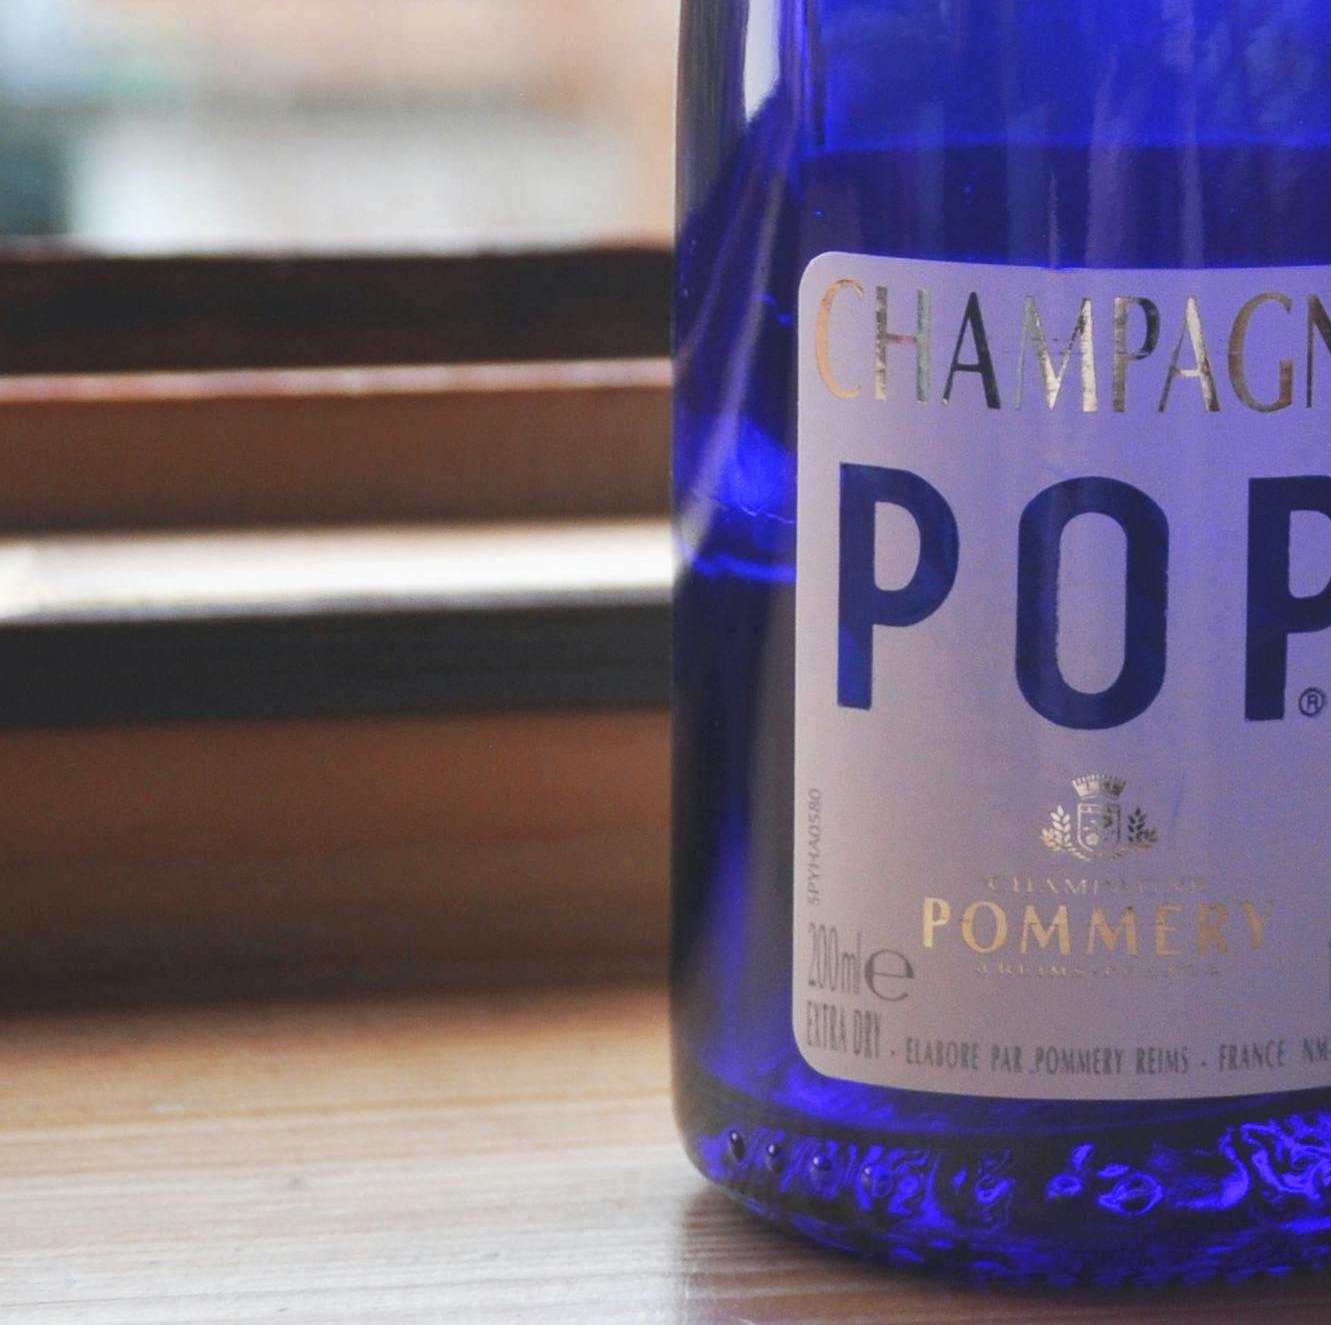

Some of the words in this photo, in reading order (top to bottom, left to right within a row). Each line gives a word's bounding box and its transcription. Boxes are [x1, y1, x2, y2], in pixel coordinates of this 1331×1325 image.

[921, 896, 1275, 957] POMMERY
[805, 1001, 847, 1053] EXTRA
[852, 1009, 882, 1059] DRY
[906, 1038, 979, 1071] ELABORE
[991, 1042, 1023, 1074] PAR
[1034, 1045, 1123, 1075] POMMERY
[1136, 1045, 1189, 1074] REIMS
[1219, 1039, 1285, 1072] FRANCE
